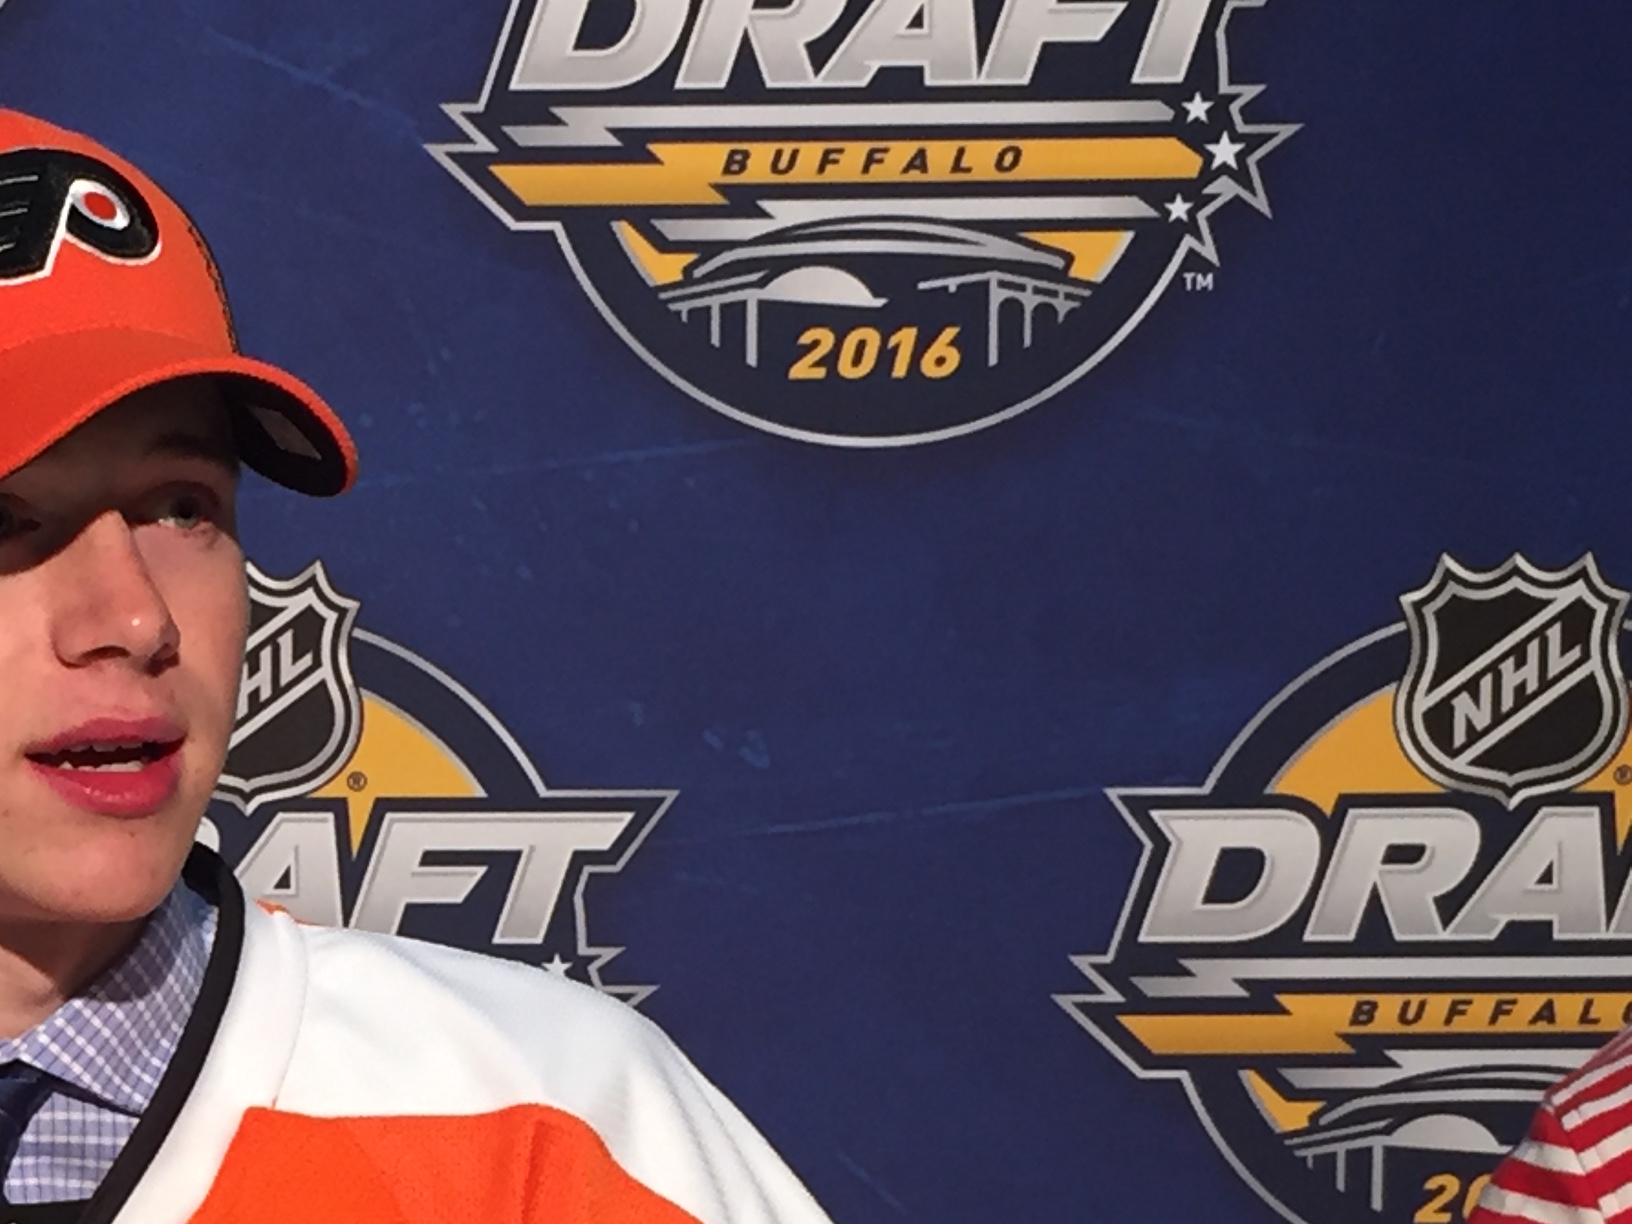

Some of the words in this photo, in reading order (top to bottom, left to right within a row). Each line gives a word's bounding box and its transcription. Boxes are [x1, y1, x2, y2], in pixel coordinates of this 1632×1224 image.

[509, 0, 1214, 90] DRAFT
[722, 145, 1024, 175] BUFFALO
[1184, 272, 1214, 291] TM
[788, 327, 961, 381] 2016
[1451, 620, 1581, 749] NHL
[194, 811, 636, 944] AFT
[1137, 805, 1632, 942] DRA
